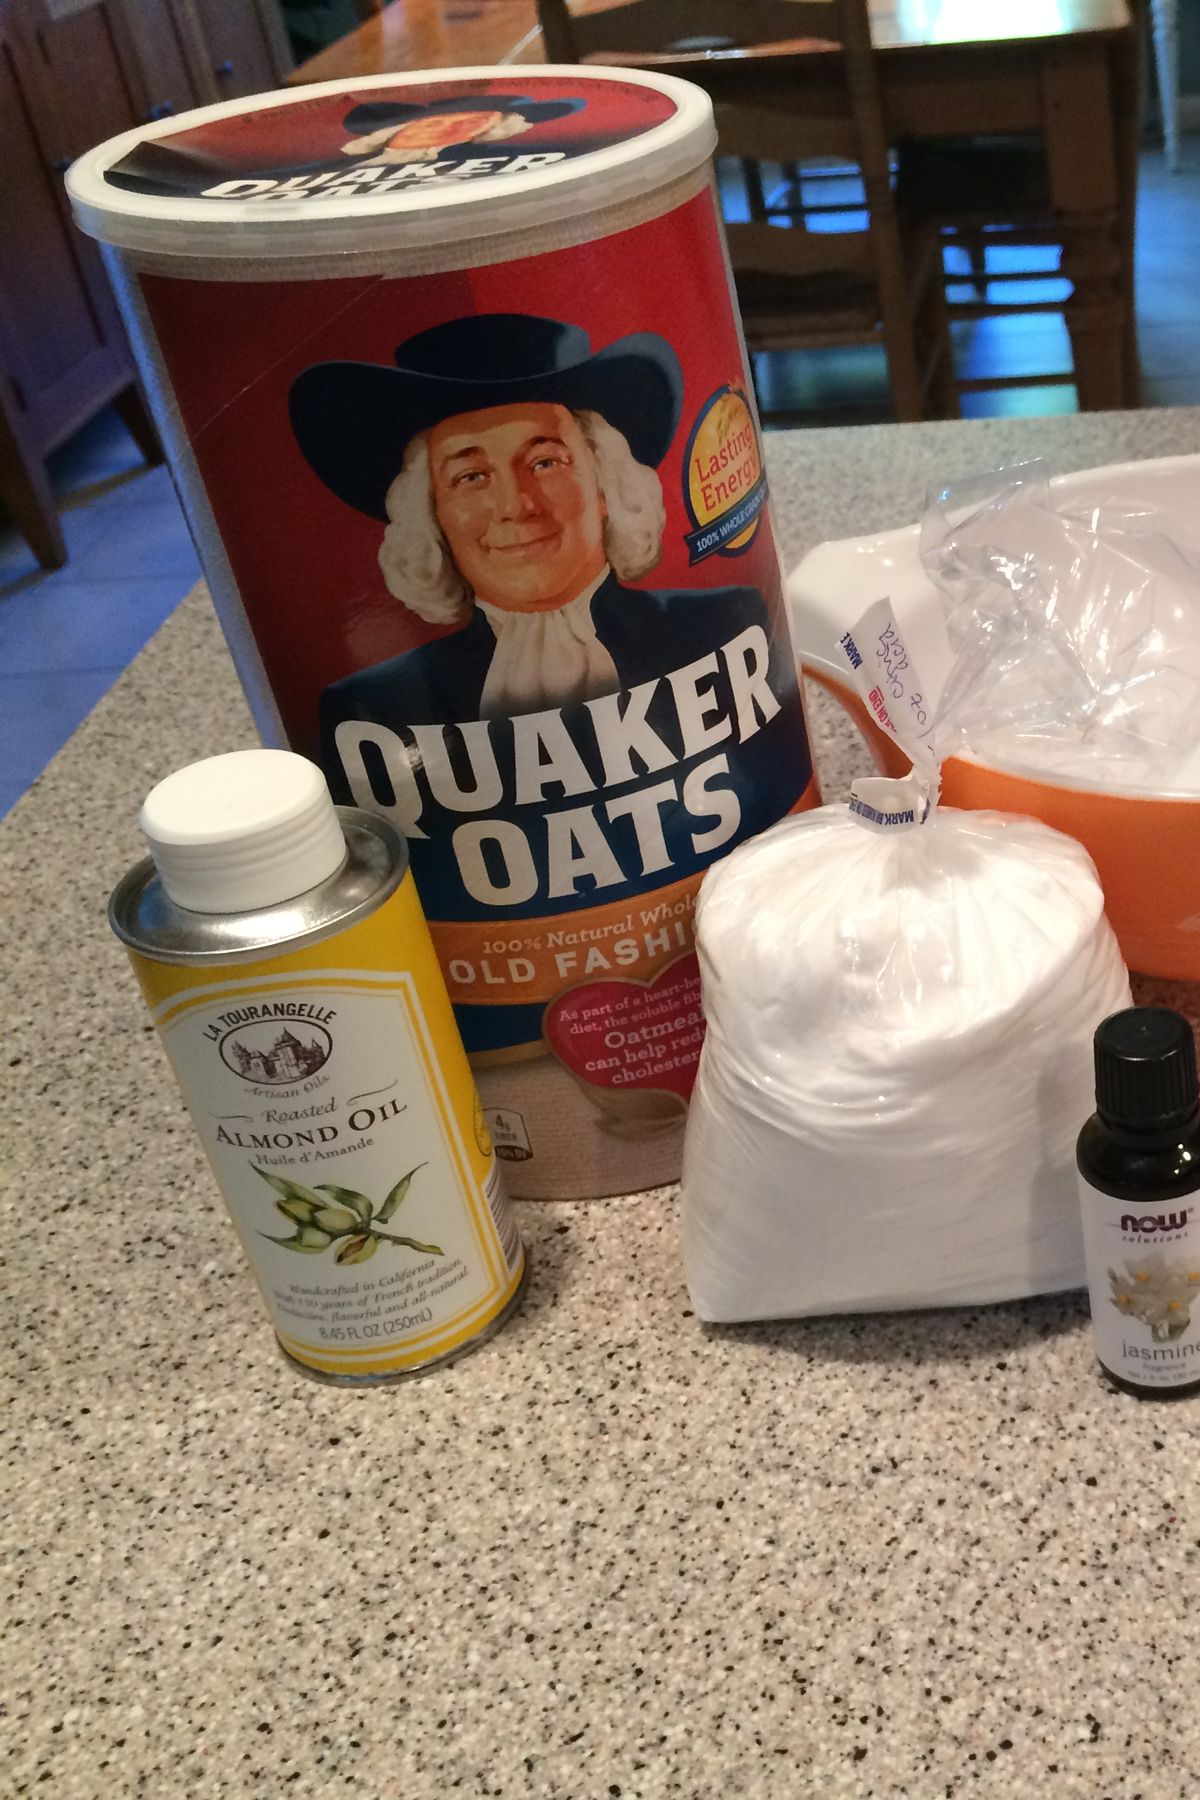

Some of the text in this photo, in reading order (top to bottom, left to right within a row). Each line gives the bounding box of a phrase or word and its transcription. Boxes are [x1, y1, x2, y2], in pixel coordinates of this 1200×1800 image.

[200, 152, 566, 198] QUAKER
[695, 422, 751, 482] Lasting
[701, 454, 758, 511] Energy
[696, 529, 720, 552] 100%
[843, 638, 863, 670] MARK
[335, 624, 782, 839] QUAKER
[452, 753, 741, 906] OATS
[884, 809, 914, 825] MARK
[482, 937, 541, 954] 100%
[547, 915, 634, 948] Natural
[450, 958, 535, 984] OLD
[202, 1003, 337, 1042] LA TOURANGELLE
[560, 1010, 579, 1021] As
[582, 1004, 612, 1020] part
[615, 997, 629, 1011] of
[604, 1015, 628, 1029] the
[631, 999, 681, 1022] soluble
[585, 1057, 621, 1072] can
[624, 1043, 666, 1065] help
[243, 1074, 330, 1099] Artisan Oils
[216, 1099, 407, 1149] ALMOND OIL
[261, 1097, 337, 1125] Roasted
[255, 1136, 374, 1166] Huile d'Amande
[378, 1259, 435, 1287] California
[348, 1328, 361, 1340] FL
[363, 1324, 379, 1338] OZ
